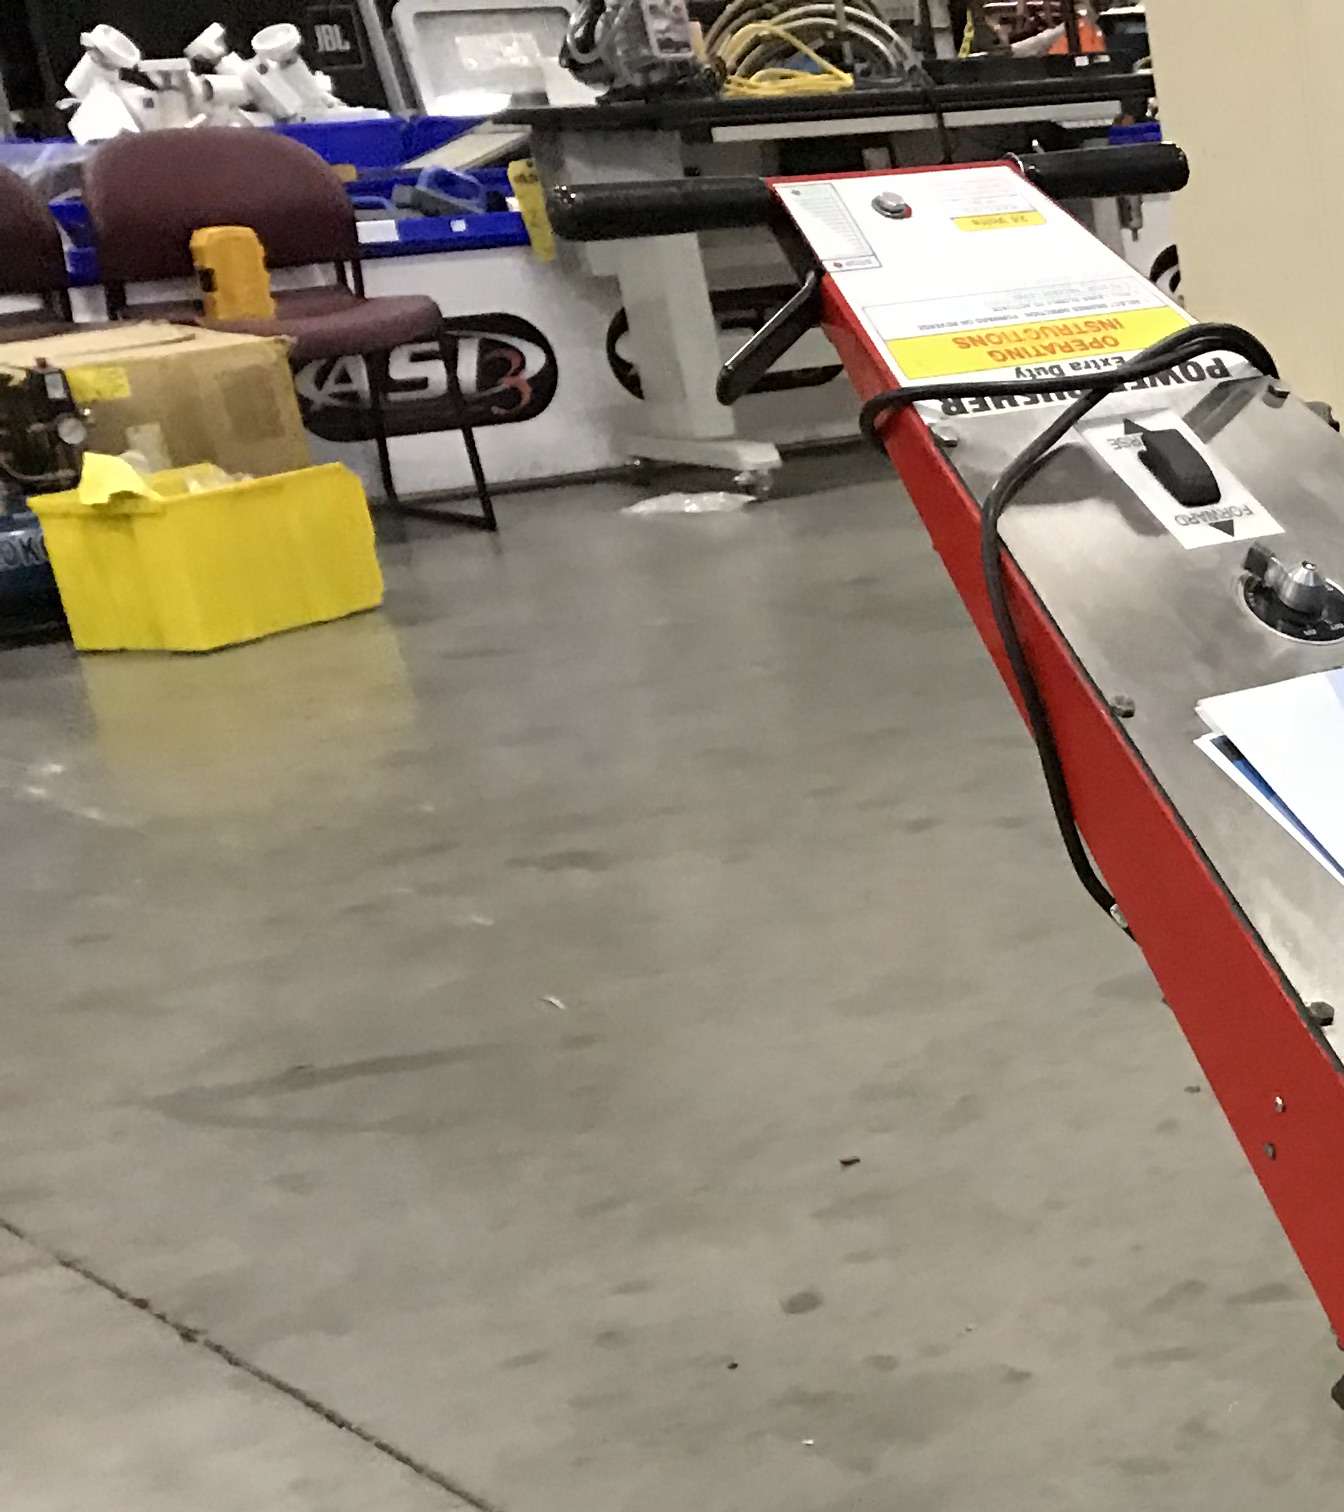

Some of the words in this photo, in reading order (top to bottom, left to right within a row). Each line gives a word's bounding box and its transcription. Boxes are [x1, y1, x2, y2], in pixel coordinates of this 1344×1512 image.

[313, 23, 351, 51] JBL
[952, 317, 1126, 350] INSTRUCTIONS
[989, 335, 1120, 363] OPERATING
[1014, 364, 1066, 380] Duty
[1070, 355, 1126, 371] Extra
[1174, 504, 1255, 527] FORWARD
